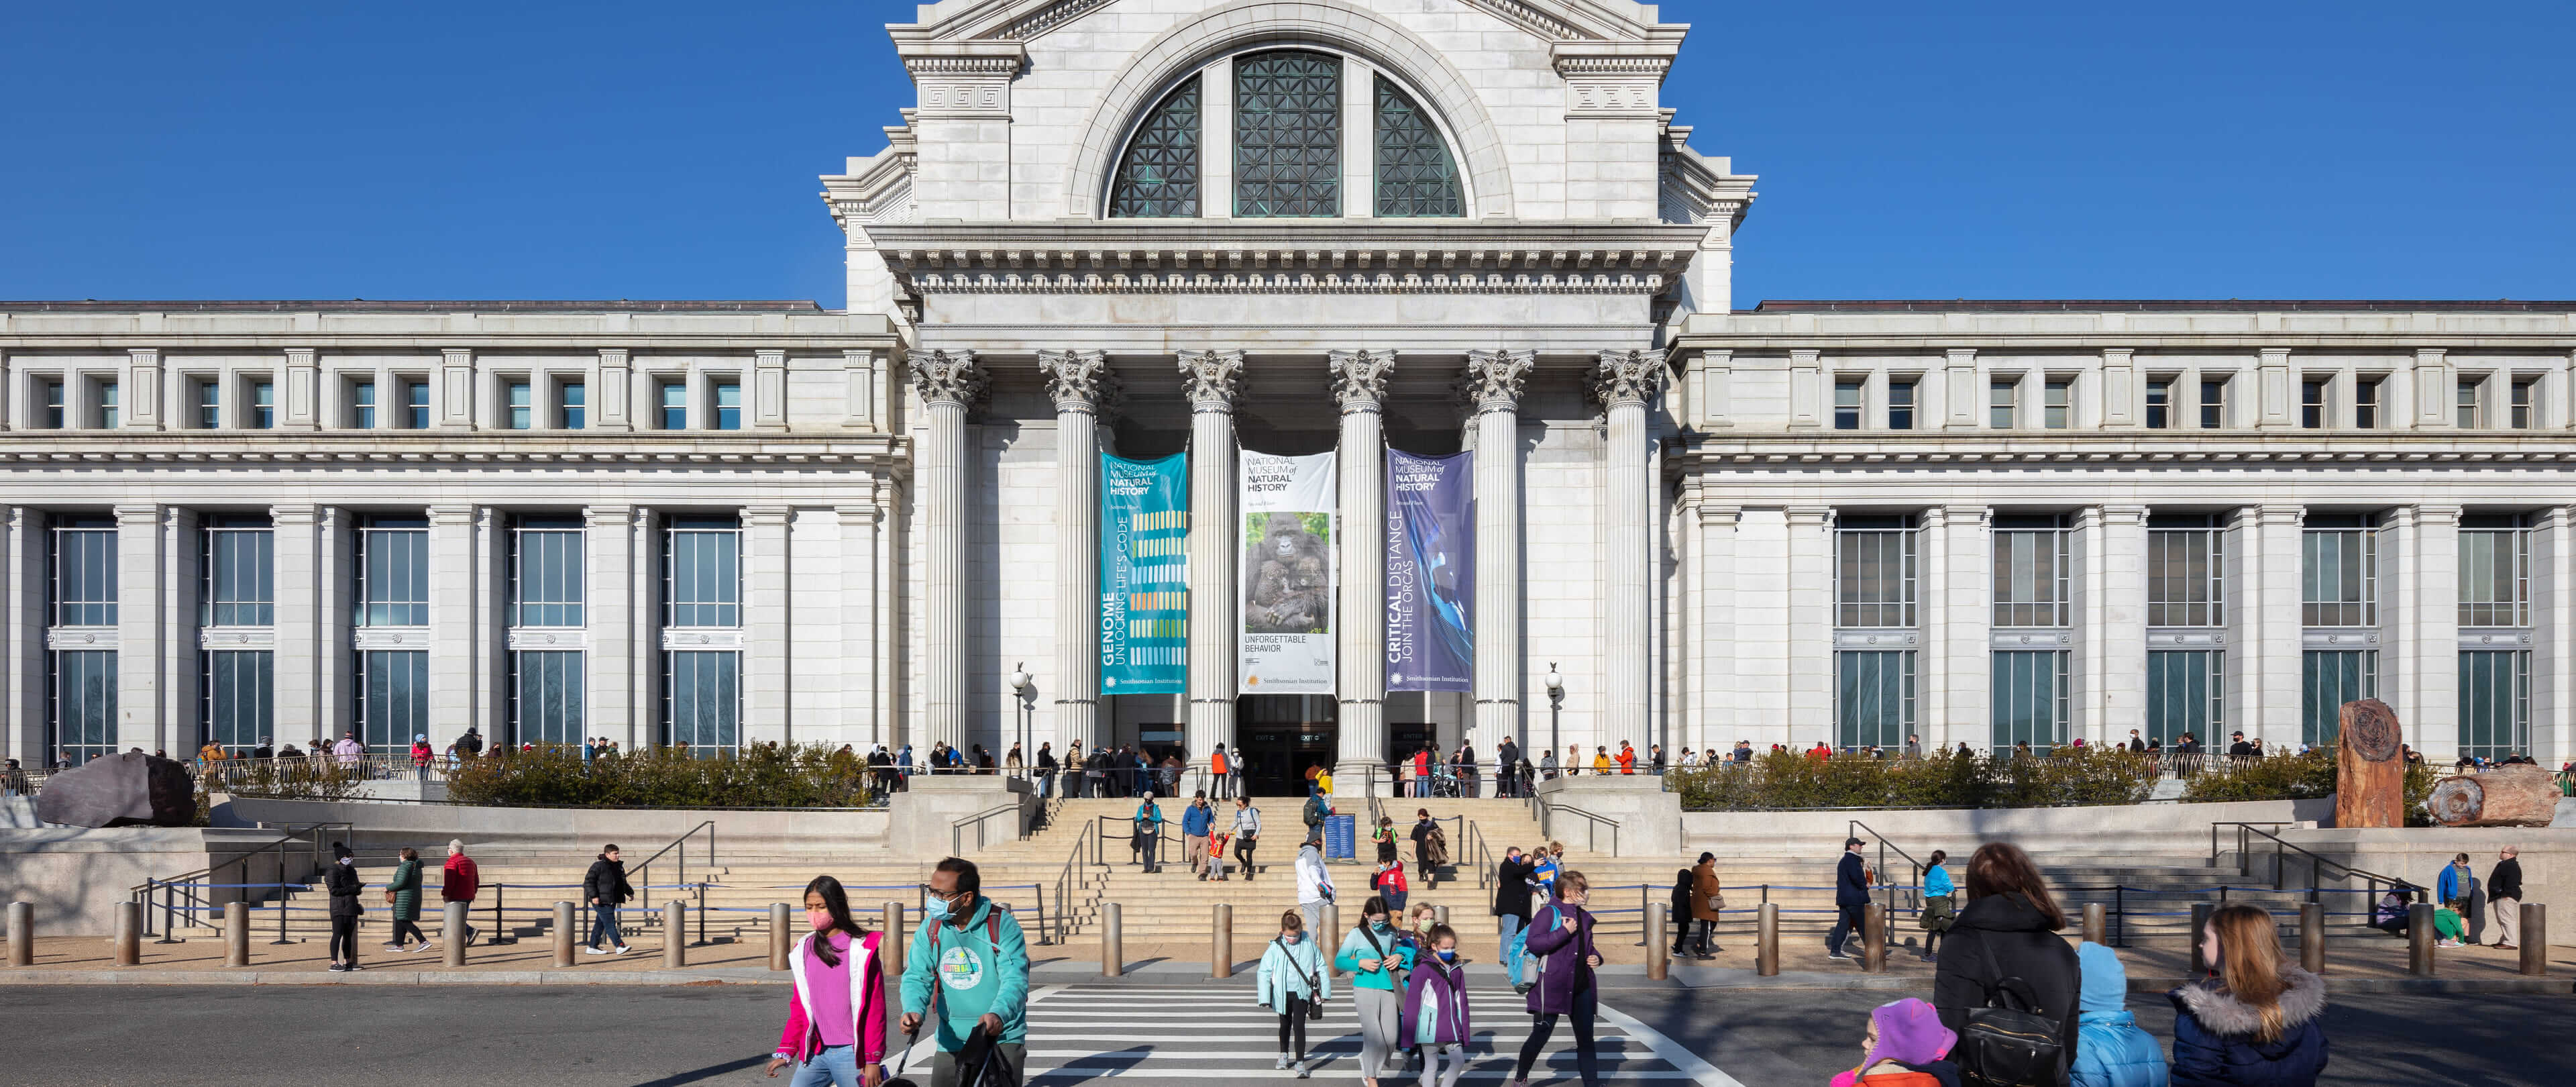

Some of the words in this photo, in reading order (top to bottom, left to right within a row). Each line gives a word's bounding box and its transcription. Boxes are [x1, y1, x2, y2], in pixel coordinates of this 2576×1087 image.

[1248, 457, 1295, 465] NATIONAL
[1395, 457, 1442, 466] NATIONAL
[1110, 461, 1155, 471] NATIONAL
[1248, 466, 1288, 474] MUSEUM
[1289, 466, 1297, 475] of
[1395, 465, 1436, 474] MUSEUM
[1437, 465, 1446, 475] of
[1110, 470, 1148, 478] MUSEUM
[1248, 474, 1292, 483] NATURAL
[1395, 474, 1440, 482] NATURAL
[1110, 477, 1153, 486] NATURAL
[1110, 486, 1149, 495] HISTORY
[1248, 483, 1287, 492] HISTORY
[1395, 482, 1436, 491] HISTORY
[1117, 516, 1128, 552] CODE
[1389, 510, 1402, 586] DISTANCE
[1402, 560, 1413, 603] ORCAS
[1402, 606, 1413, 630] THE
[1103, 592, 1114, 666] GENOME
[1116, 592, 1126, 665] UNLOCKING
[1389, 591, 1401, 664] CRITICAL
[1245, 635, 1306, 643] UNFORGETTABLE
[1245, 644, 1281, 652] BEHAVIOR
[1402, 632, 1413, 662] JOIN
